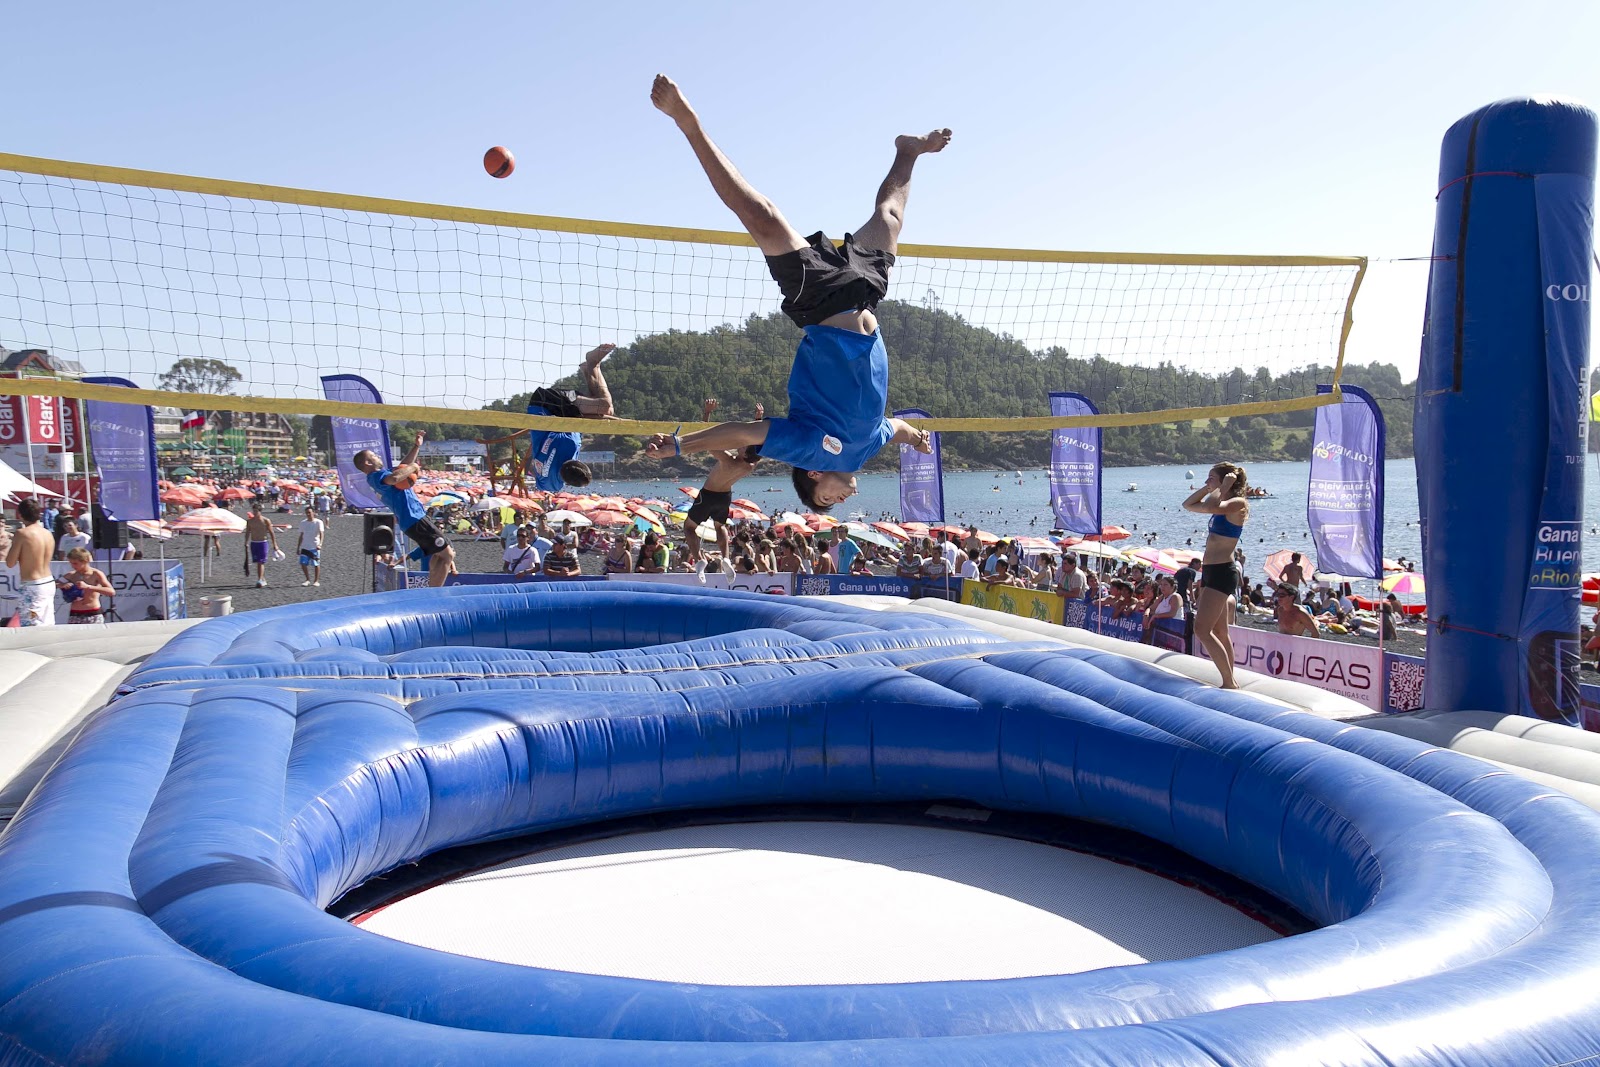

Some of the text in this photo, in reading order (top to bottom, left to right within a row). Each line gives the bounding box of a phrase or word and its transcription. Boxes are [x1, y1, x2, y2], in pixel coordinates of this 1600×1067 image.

[39, 395, 55, 439] Claro
[1538, 526, 1579, 543] Gana
[838, 582, 863, 592] Gana
[865, 583, 877, 592] un
[879, 583, 901, 594] Viaje
[1108, 617, 1118, 626] un
[1119, 617, 1137, 632] Viaje
[1136, 623, 1143, 632] a
[1200, 642, 1371, 690] UPOLIGAS
